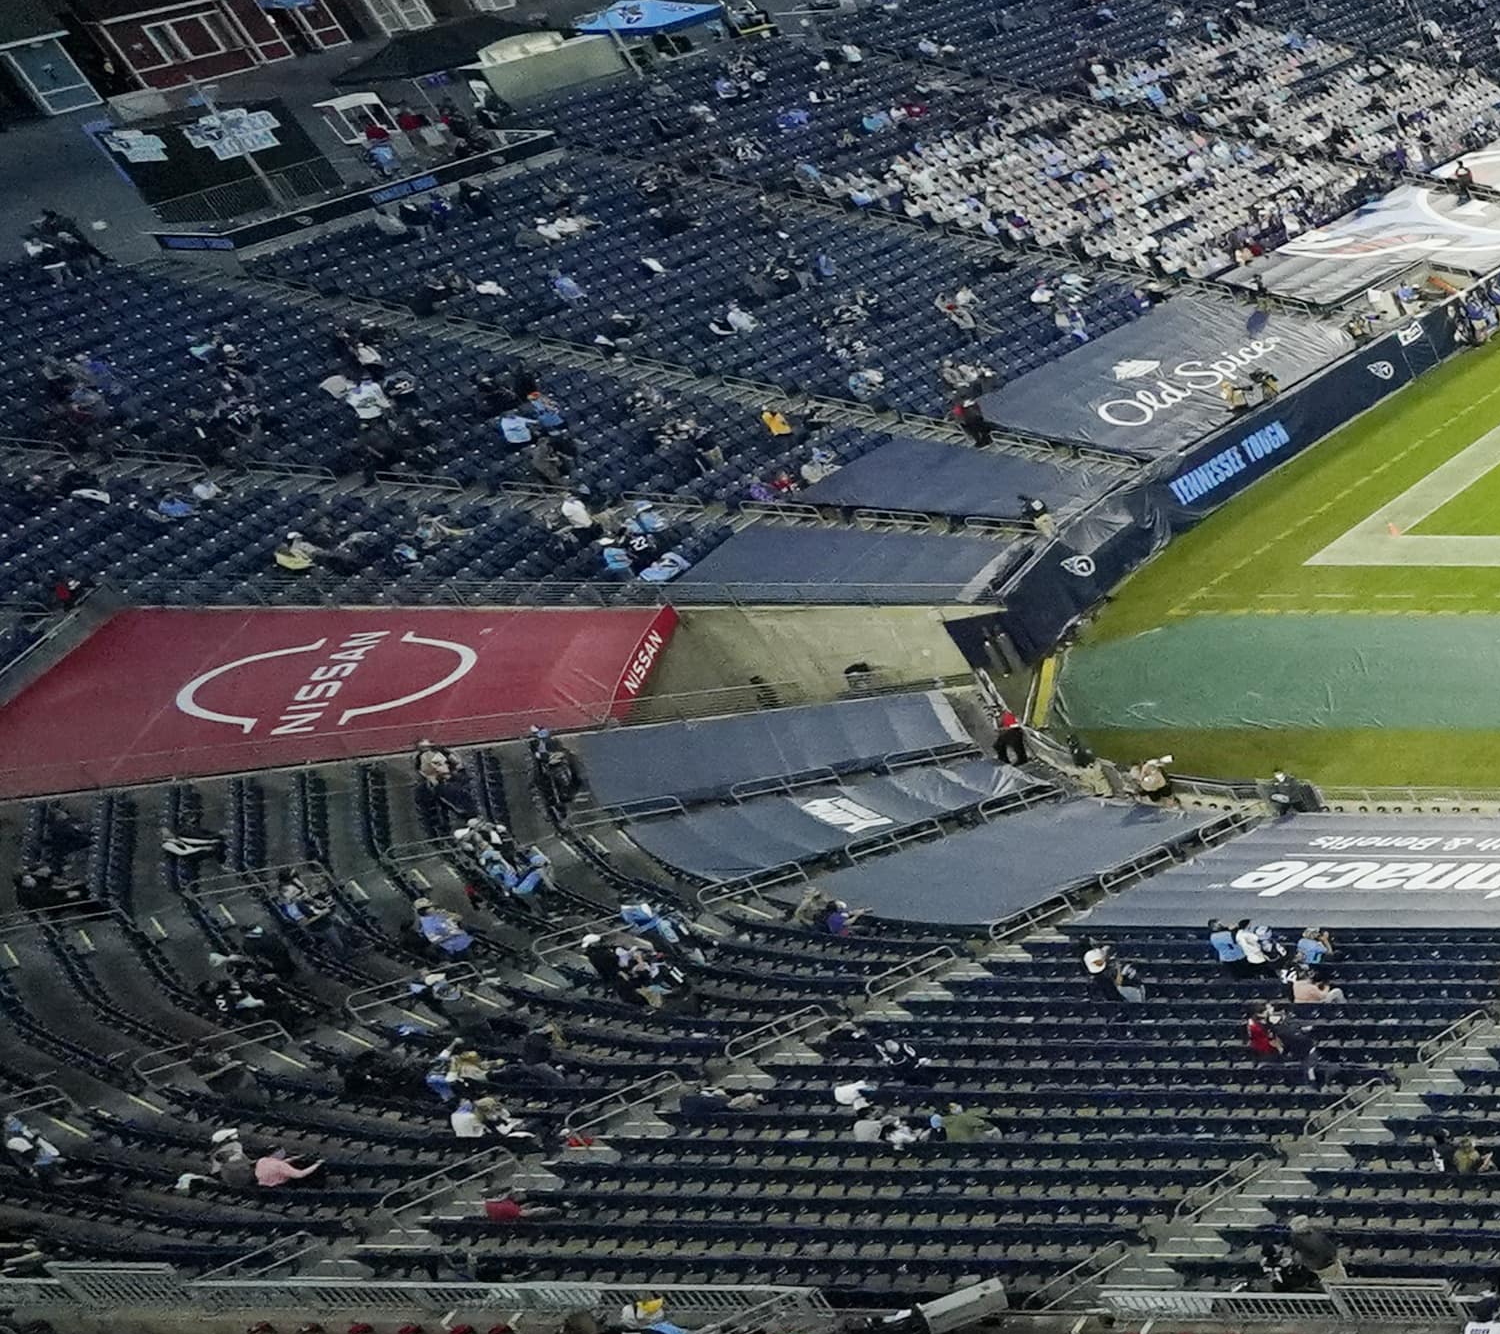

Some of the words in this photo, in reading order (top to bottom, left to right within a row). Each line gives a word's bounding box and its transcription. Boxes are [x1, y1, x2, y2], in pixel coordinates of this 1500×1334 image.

[1098, 380, 1191, 427] Old
[1175, 336, 1279, 389] Spice
[1168, 447, 1248, 506] TENNESSEE
[1242, 420, 1291, 462] TOUGH
[270, 630, 391, 736] NISSAN
[623, 630, 665, 695] NISSAN
[1308, 835, 1441, 851] Benefits
[1443, 836, 1470, 850] &
